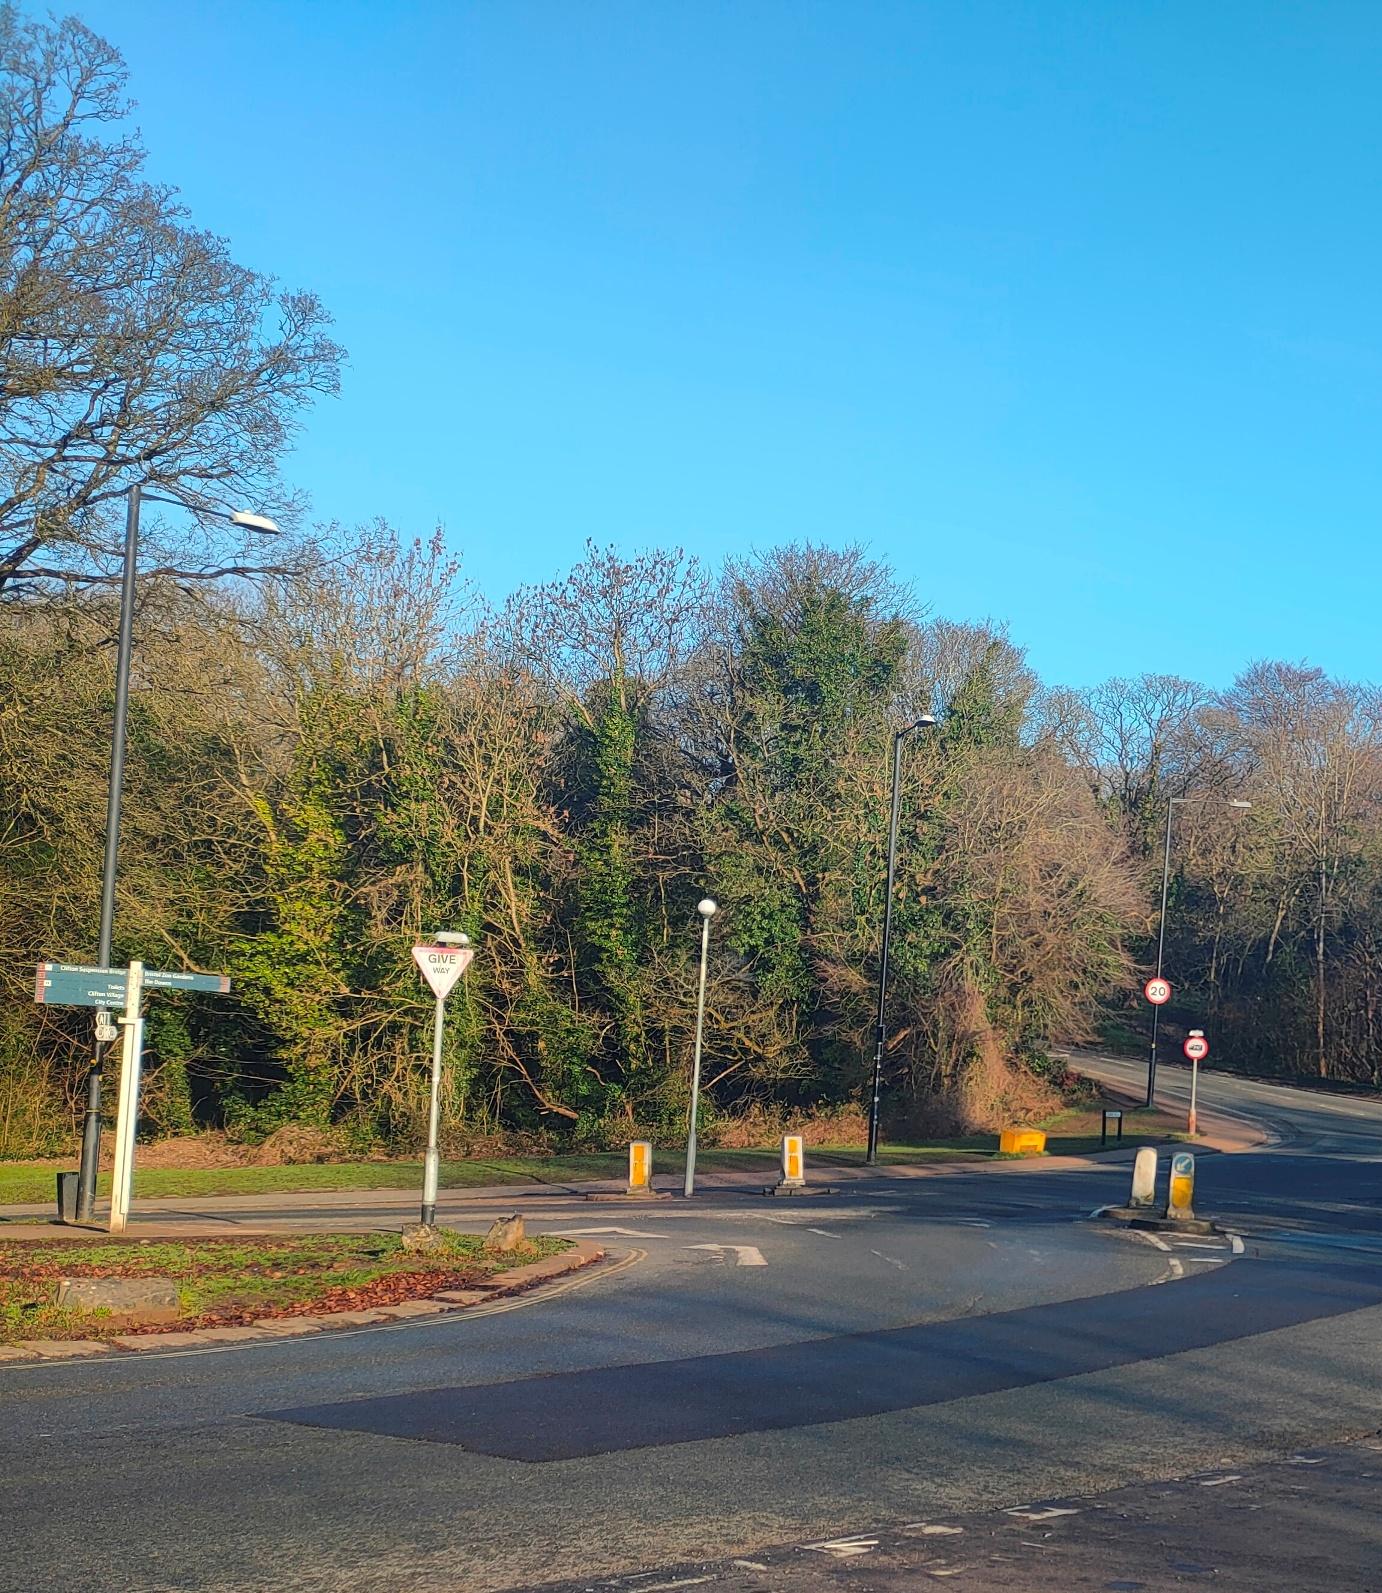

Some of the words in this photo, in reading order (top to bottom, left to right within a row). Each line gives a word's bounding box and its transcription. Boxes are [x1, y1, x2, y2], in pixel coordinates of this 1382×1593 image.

[428, 954, 456, 964] GIVE
[106, 992, 124, 1000] Village
[1151, 986, 1166, 996] 20
